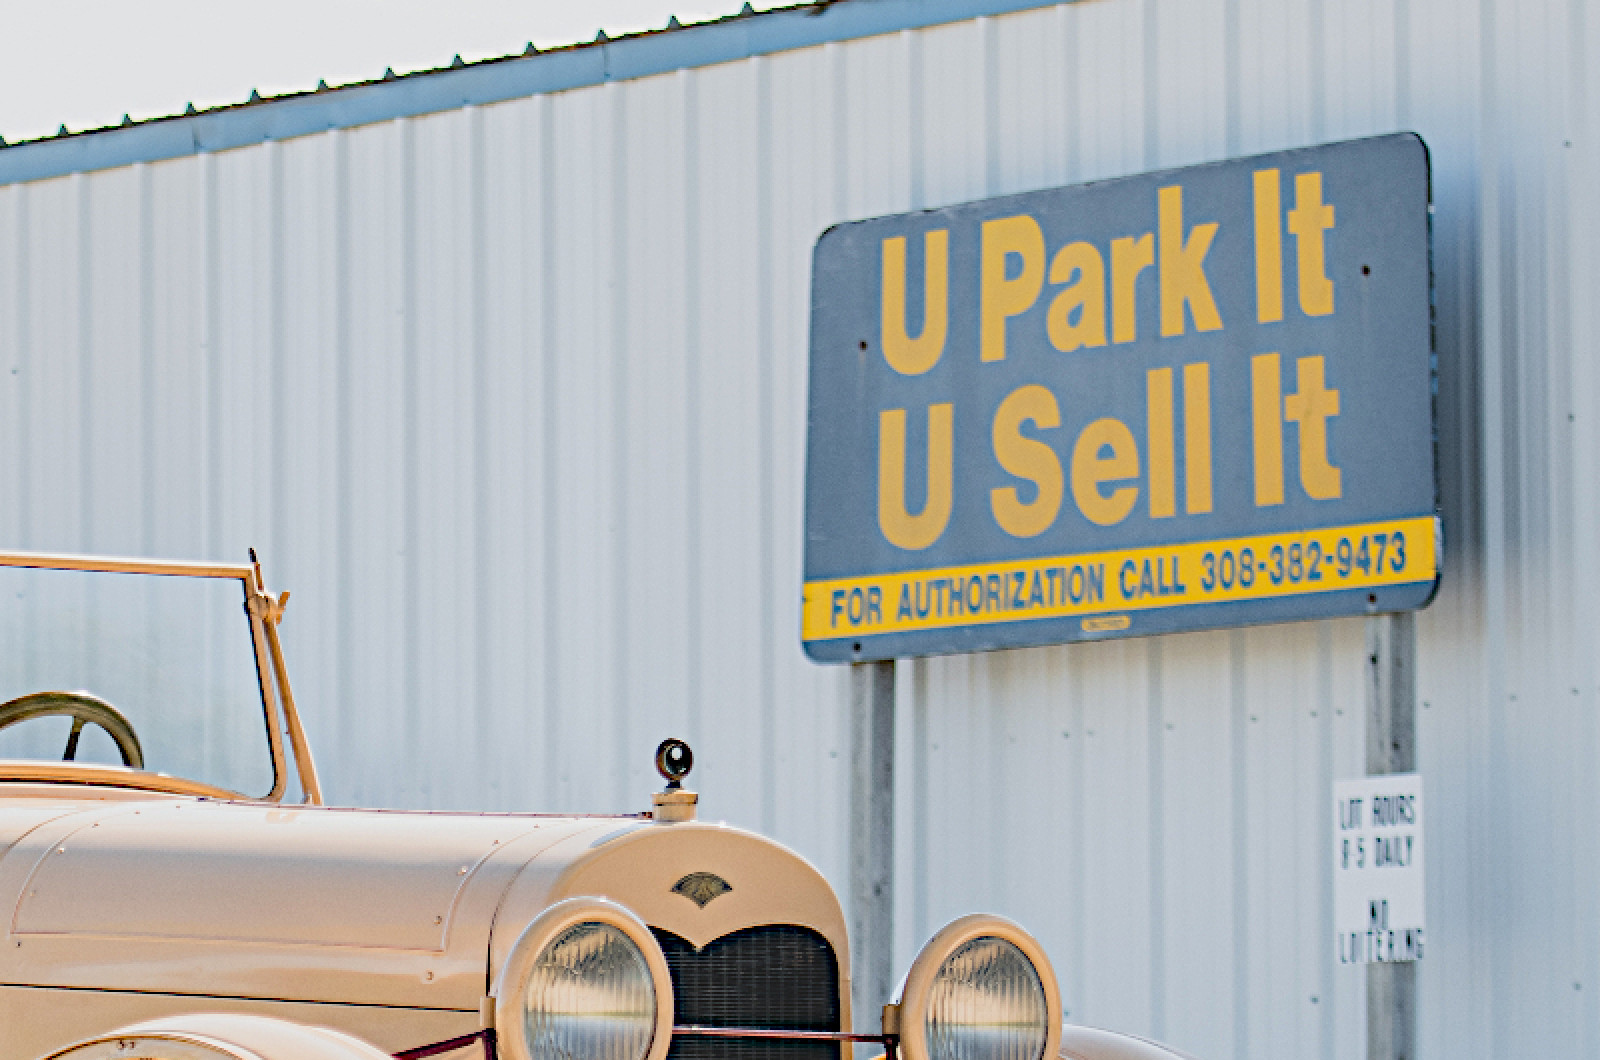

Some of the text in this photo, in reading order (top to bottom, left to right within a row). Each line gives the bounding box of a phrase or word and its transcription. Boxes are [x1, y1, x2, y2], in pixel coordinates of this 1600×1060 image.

[881, 167, 1335, 376] U Park It
[877, 352, 1343, 551] U Sell It
[831, 530, 1407, 629] FOR AUTHORIZATION CALL 308-382-9473
[1374, 834, 1414, 868] DAILY
